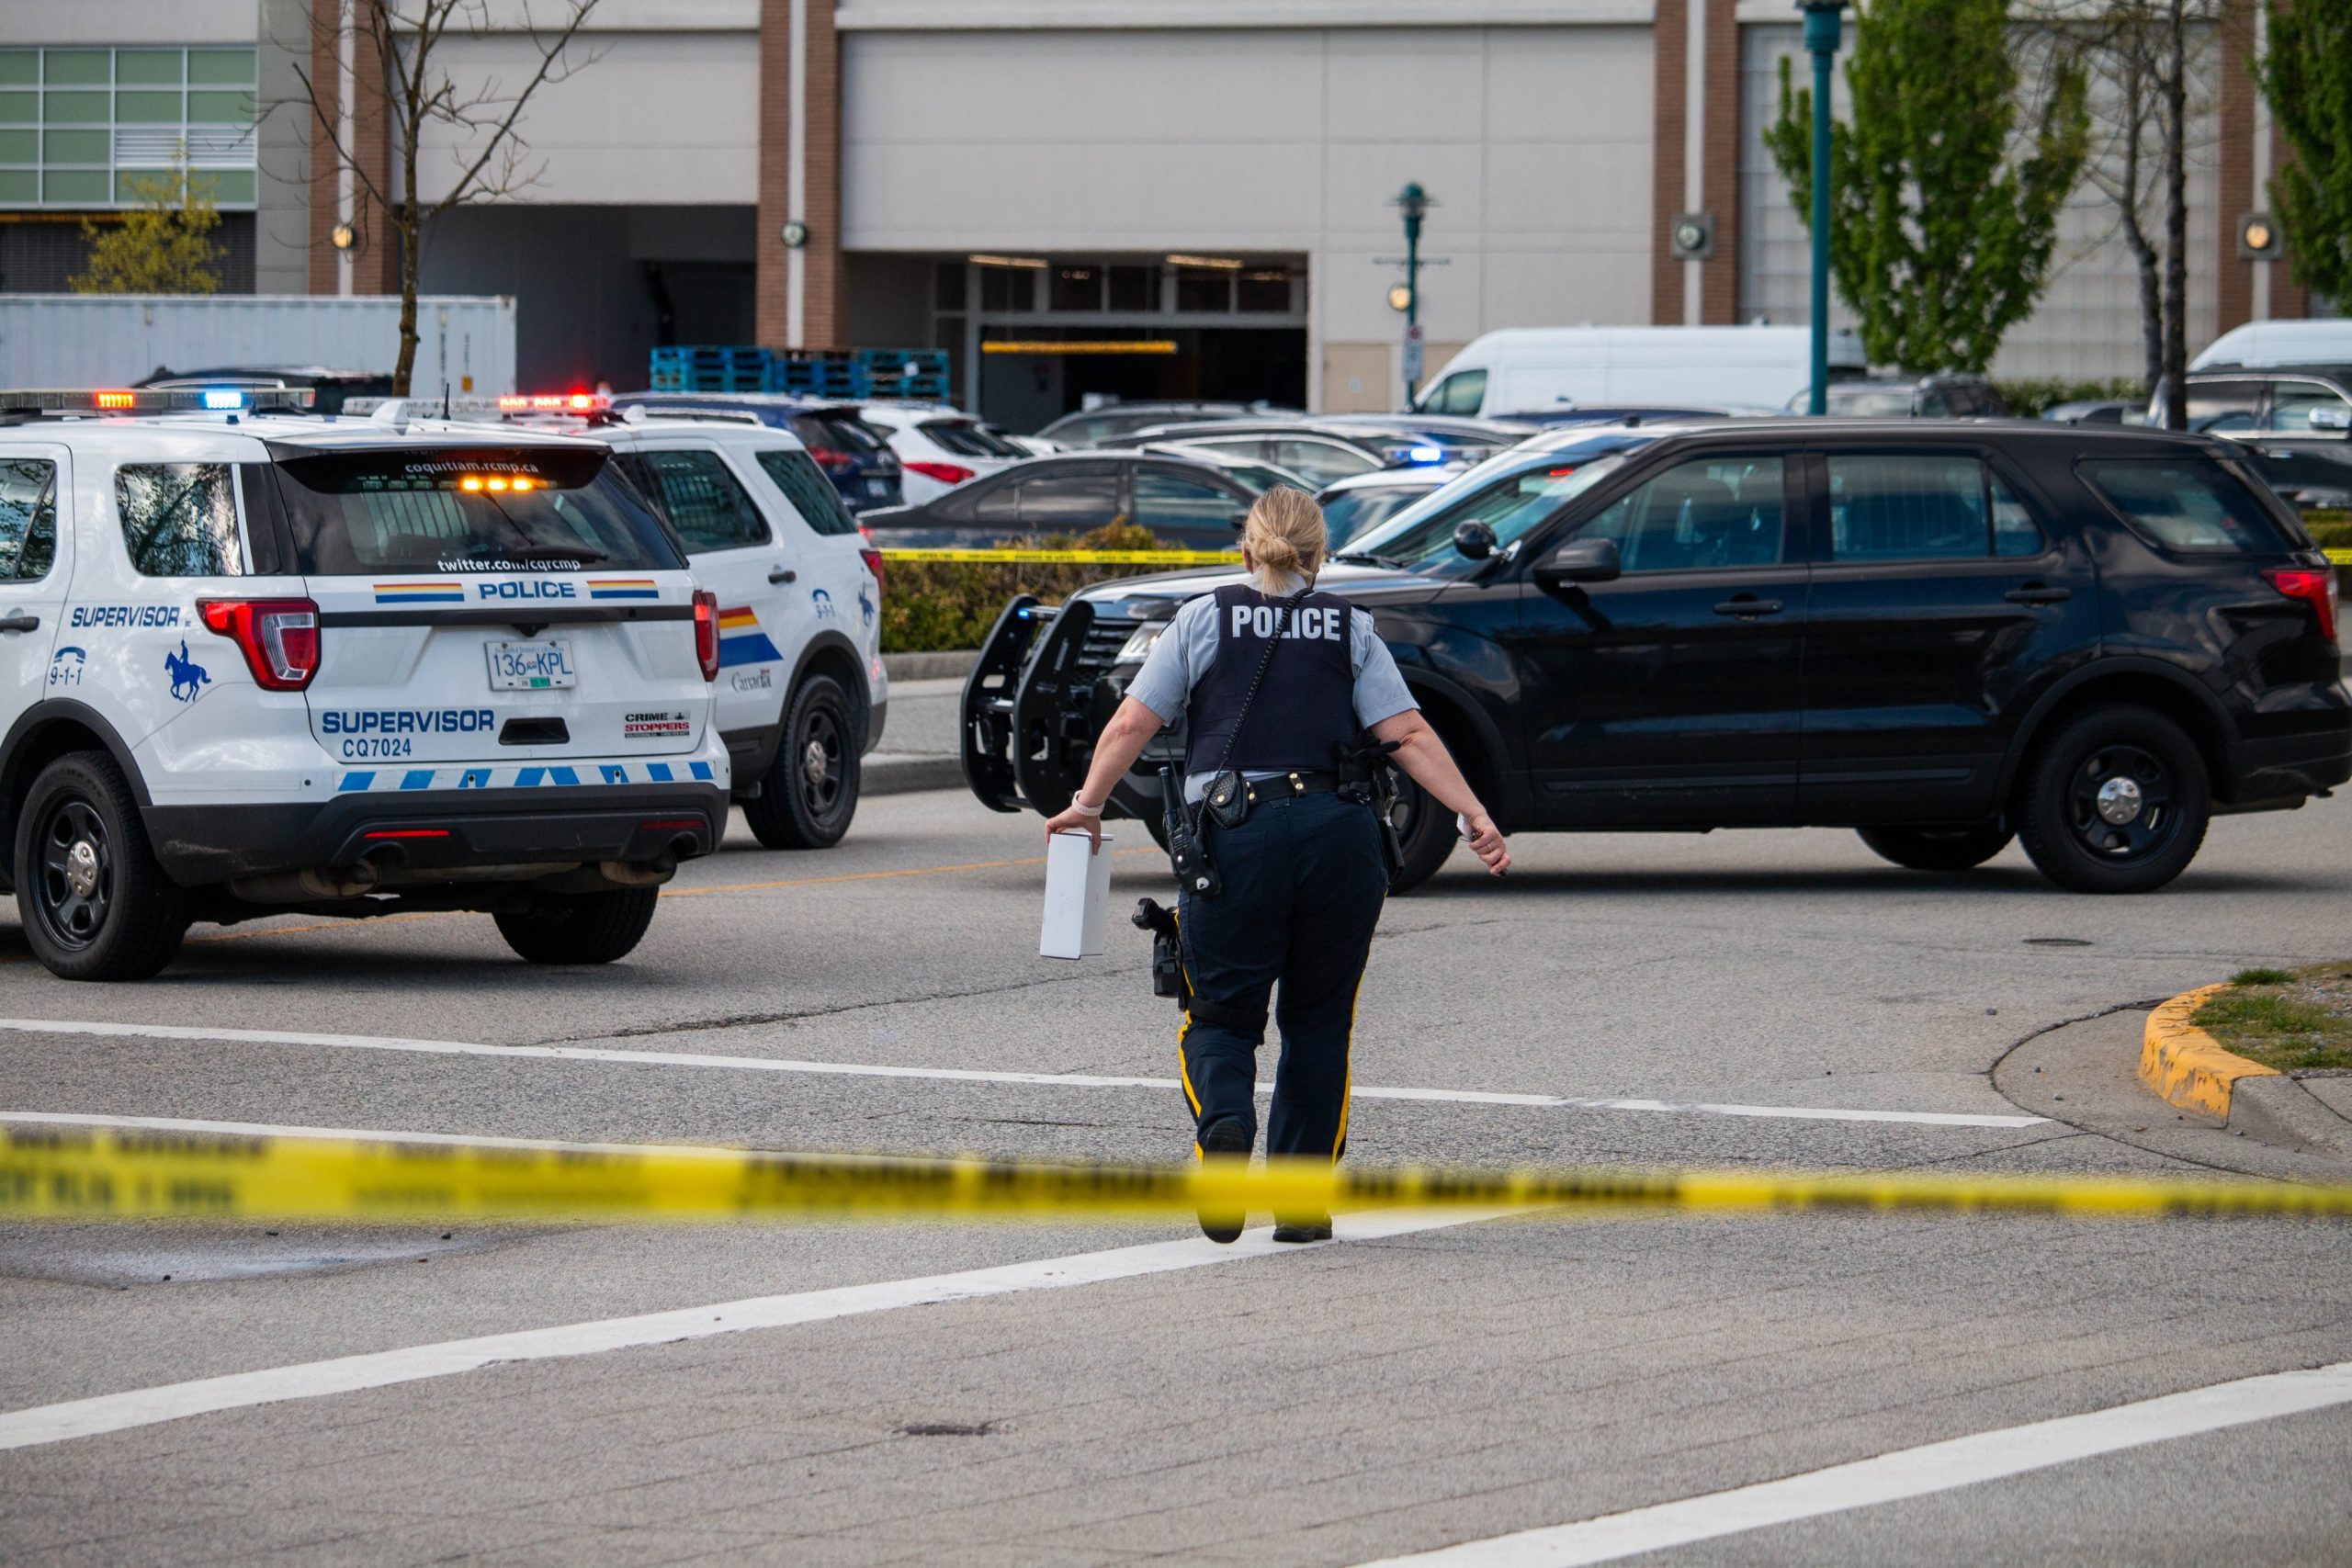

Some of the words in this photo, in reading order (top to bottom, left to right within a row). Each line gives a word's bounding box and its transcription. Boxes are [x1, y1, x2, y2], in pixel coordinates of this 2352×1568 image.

[404, 460, 539, 474] coquitlam.rcmp.ca
[478, 581, 576, 600] POLICE
[71, 606, 181, 627] SUPERVISOR
[1231, 604, 1341, 641] POLICE
[493, 653, 526, 677] 136
[536, 652, 573, 675] KPL
[50, 666, 83, 685] 9-1-1
[731, 671, 772, 693] Canada
[322, 710, 494, 734] SUPERVISOR
[625, 722, 690, 732] STOPPERS
[626, 712, 669, 722] CRIME
[343, 738, 412, 758] CQ7024
